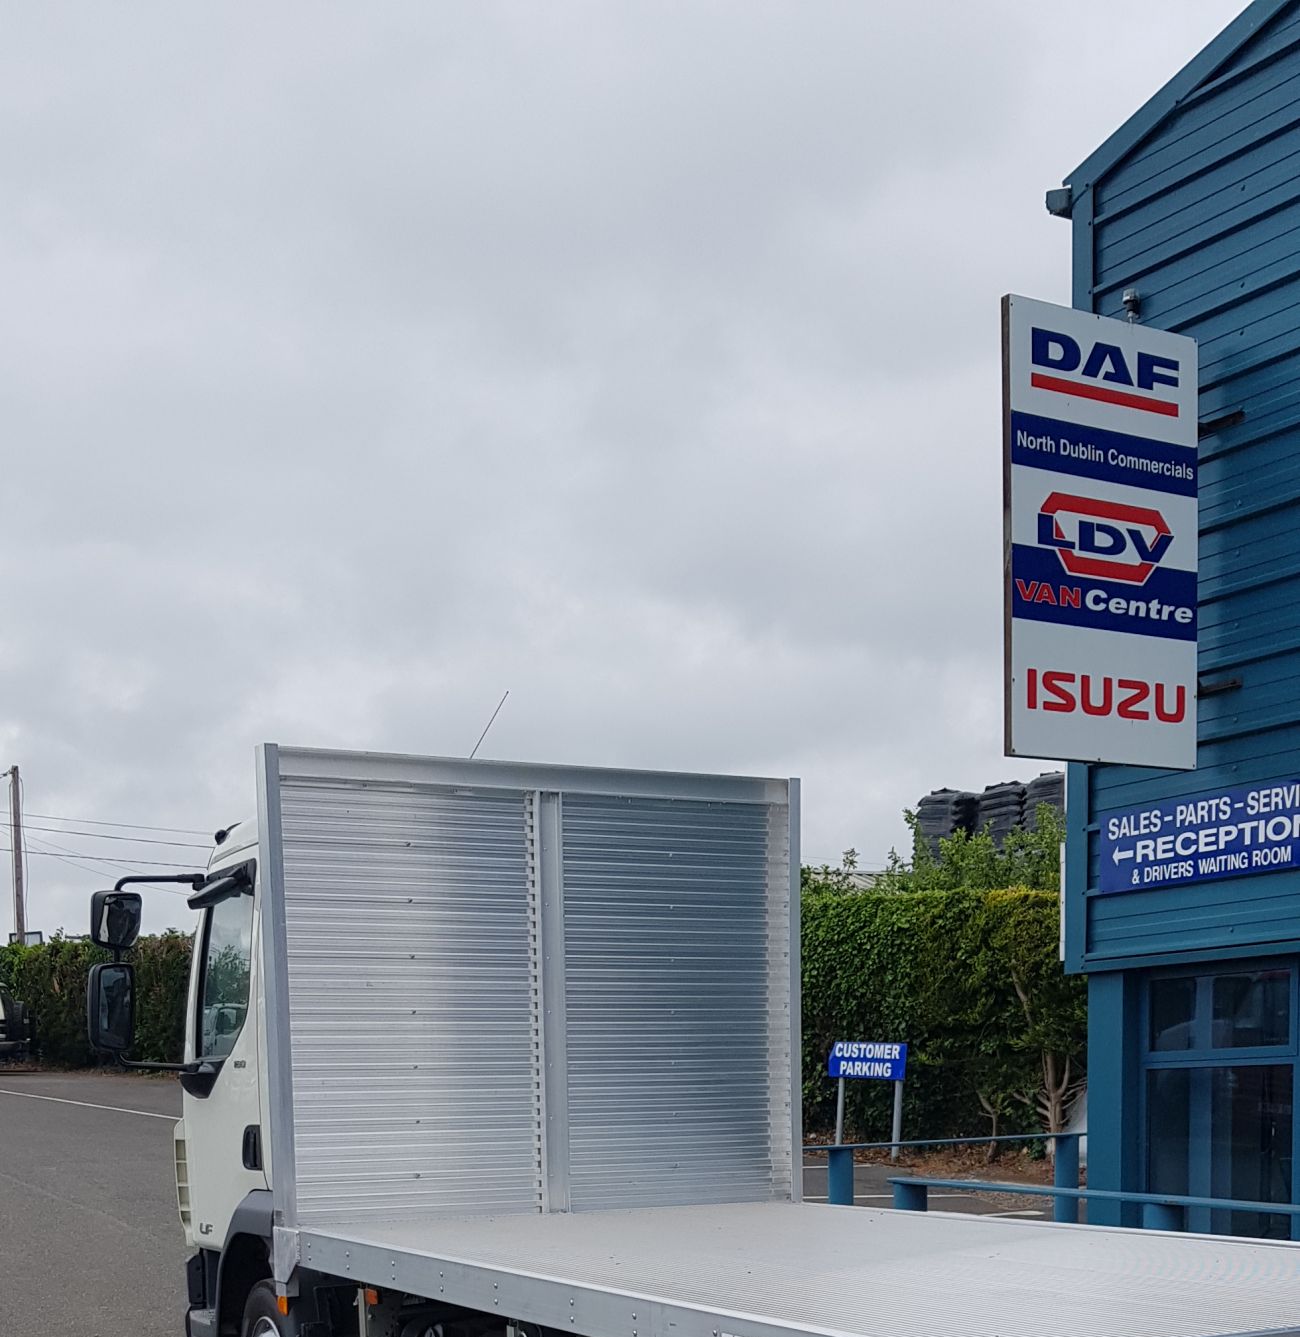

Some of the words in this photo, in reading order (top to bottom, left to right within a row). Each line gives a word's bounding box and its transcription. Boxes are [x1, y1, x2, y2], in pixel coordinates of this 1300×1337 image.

[1032, 327, 1179, 390] DAF
[1017, 430, 1055, 453] North
[1060, 439, 1104, 462] Dublin
[1108, 449, 1194, 480] Commercials
[1038, 513, 1174, 563] LDV
[1027, 668, 1185, 723] ISUZU
[1108, 810, 1161, 840] SALES
[1176, 796, 1231, 828] PARTS
[1132, 868, 1140, 884] &
[1144, 860, 1194, 883] DRIVERS
[1199, 852, 1248, 875] WAITING
[1252, 846, 1291, 867] ROOM
[835, 1043, 900, 1059] CUSTOMER
[840, 1061, 892, 1077] PARKING
